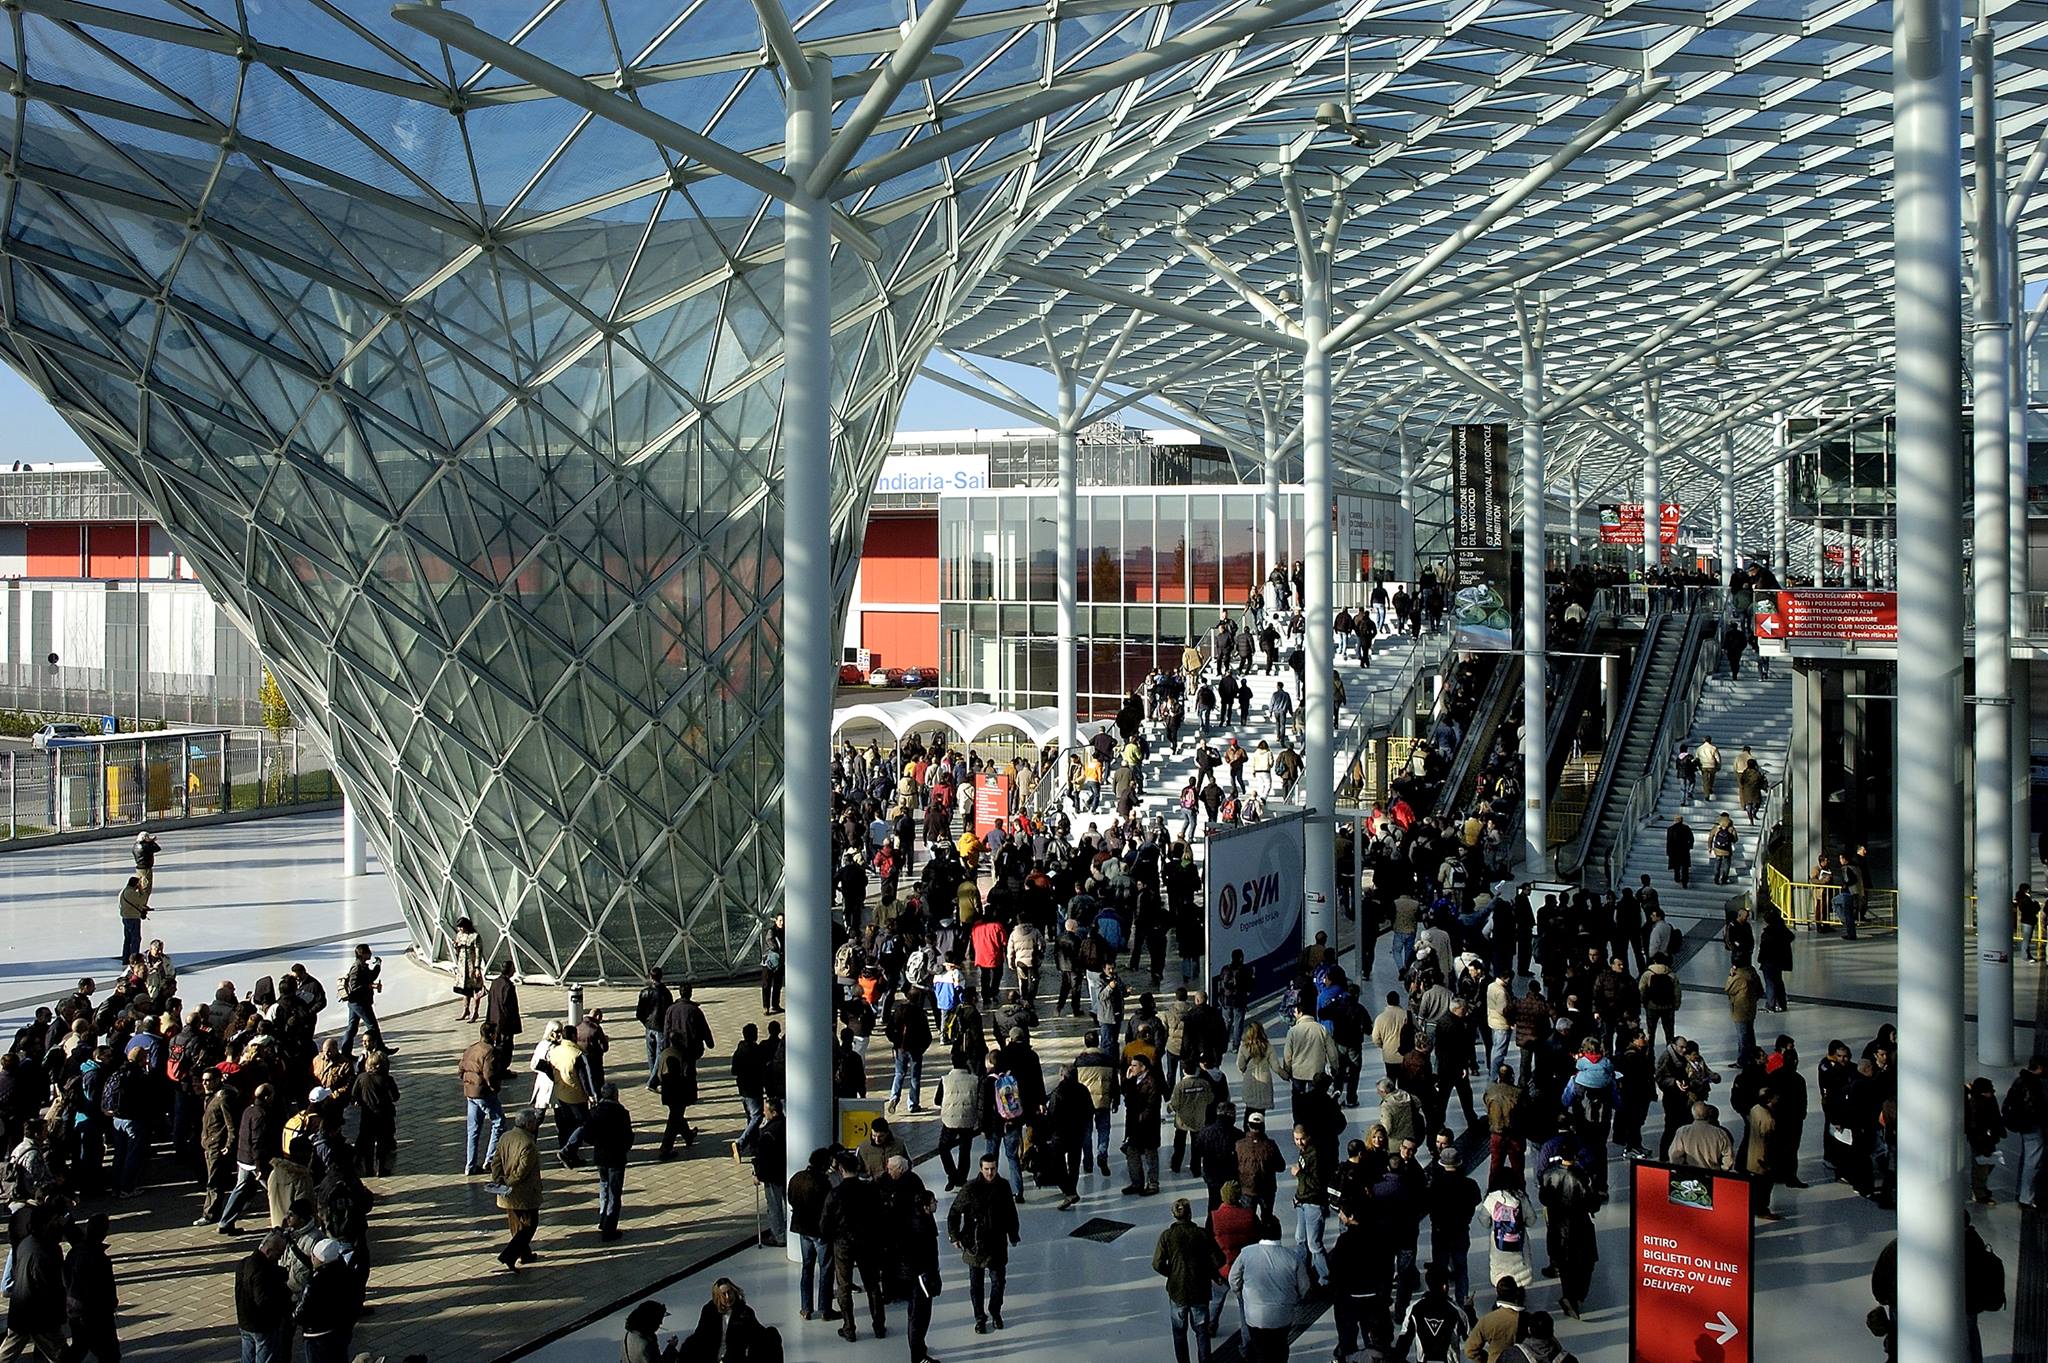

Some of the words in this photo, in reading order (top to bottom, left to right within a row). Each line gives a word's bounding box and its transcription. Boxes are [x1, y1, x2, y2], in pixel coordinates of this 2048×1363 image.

[1459, 425, 1467, 486] INTERNAZIONALE
[1484, 425, 1492, 475] MOTORCYCLE
[879, 471, 985, 490] ndiaria-Sai
[1460, 487, 1468, 533] ESPOSIZIONE
[1468, 487, 1476, 531] MOTOCICLO
[1485, 475, 1493, 533] INTERNATIONAL
[1468, 532, 1477, 546] DEL
[1493, 505, 1502, 546] EXHIBITION
[1240, 871, 1279, 916] SYM
[1643, 1235, 1678, 1249] RITIRO
[1643, 1249, 1692, 1266] BIGLIETTI
[1694, 1257, 1711, 1269] ON
[1714, 1261, 1738, 1274] LINE
[1642, 1277, 1695, 1294] DELIVERY
[1643, 1263, 1685, 1279] TICKETS
[1687, 1271, 1705, 1282] ON
[1707, 1274, 1732, 1287] LINE
